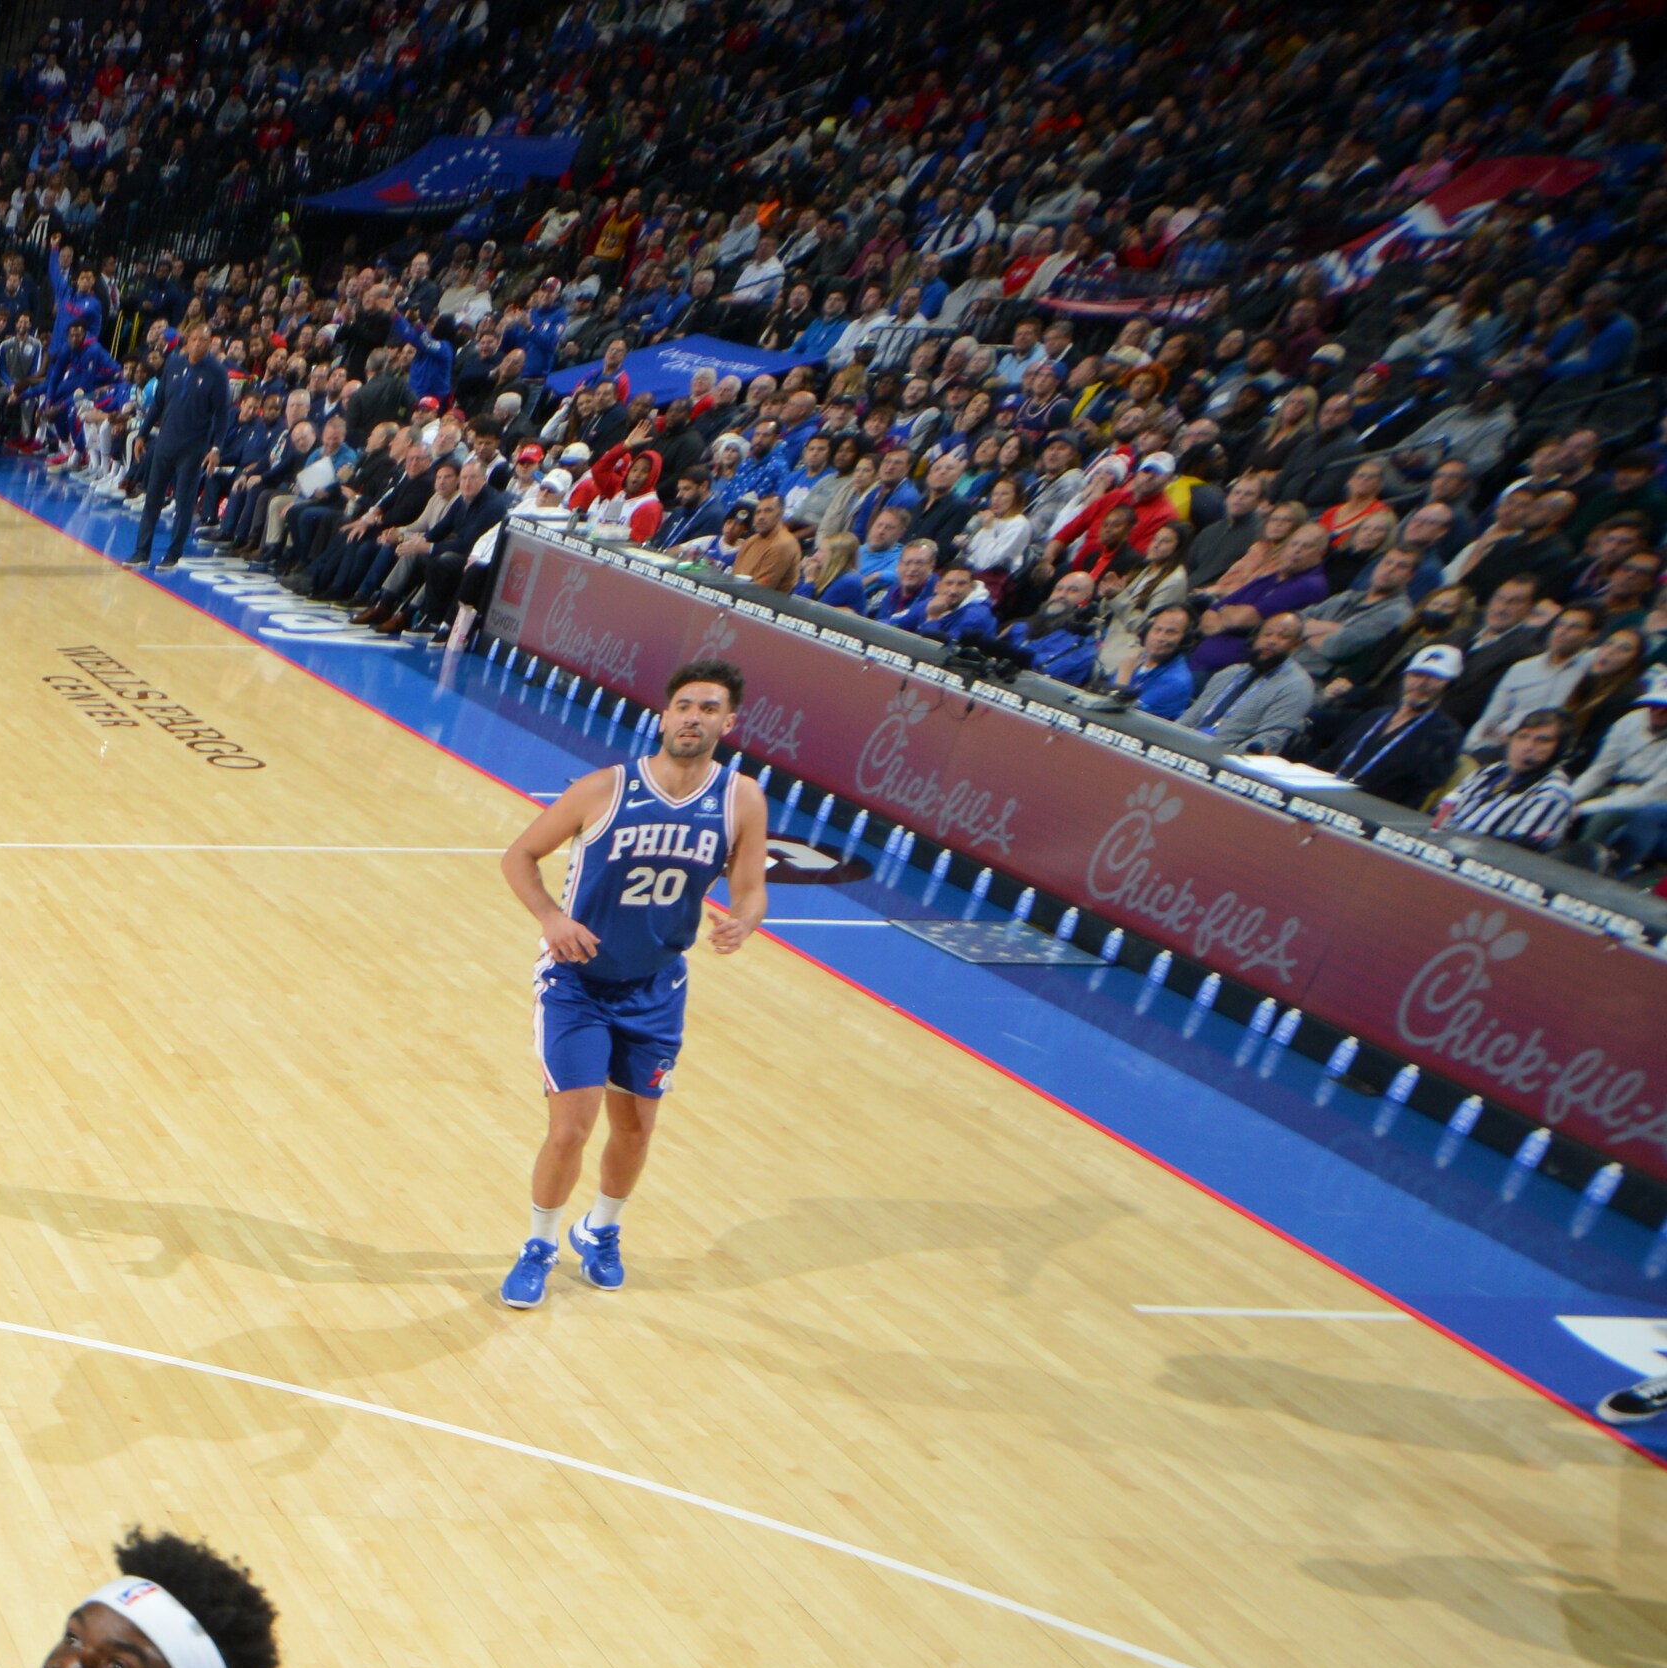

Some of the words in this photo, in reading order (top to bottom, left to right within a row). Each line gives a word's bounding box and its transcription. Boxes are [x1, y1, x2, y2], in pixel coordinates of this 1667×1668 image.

[490, 609, 519, 633] TOYOTA
[542, 583, 641, 686] Chick-fil-A
[41, 675, 140, 728] CENTER
[56, 644, 169, 700] WELLS
[132, 703, 267, 770] FARGO
[629, 780, 640, 792] 6
[855, 713, 1017, 856] Chick-fil-A
[607, 824, 719, 865] PHILA
[620, 866, 688, 906] 20
[1085, 808, 1301, 984] Chick-fil-A
